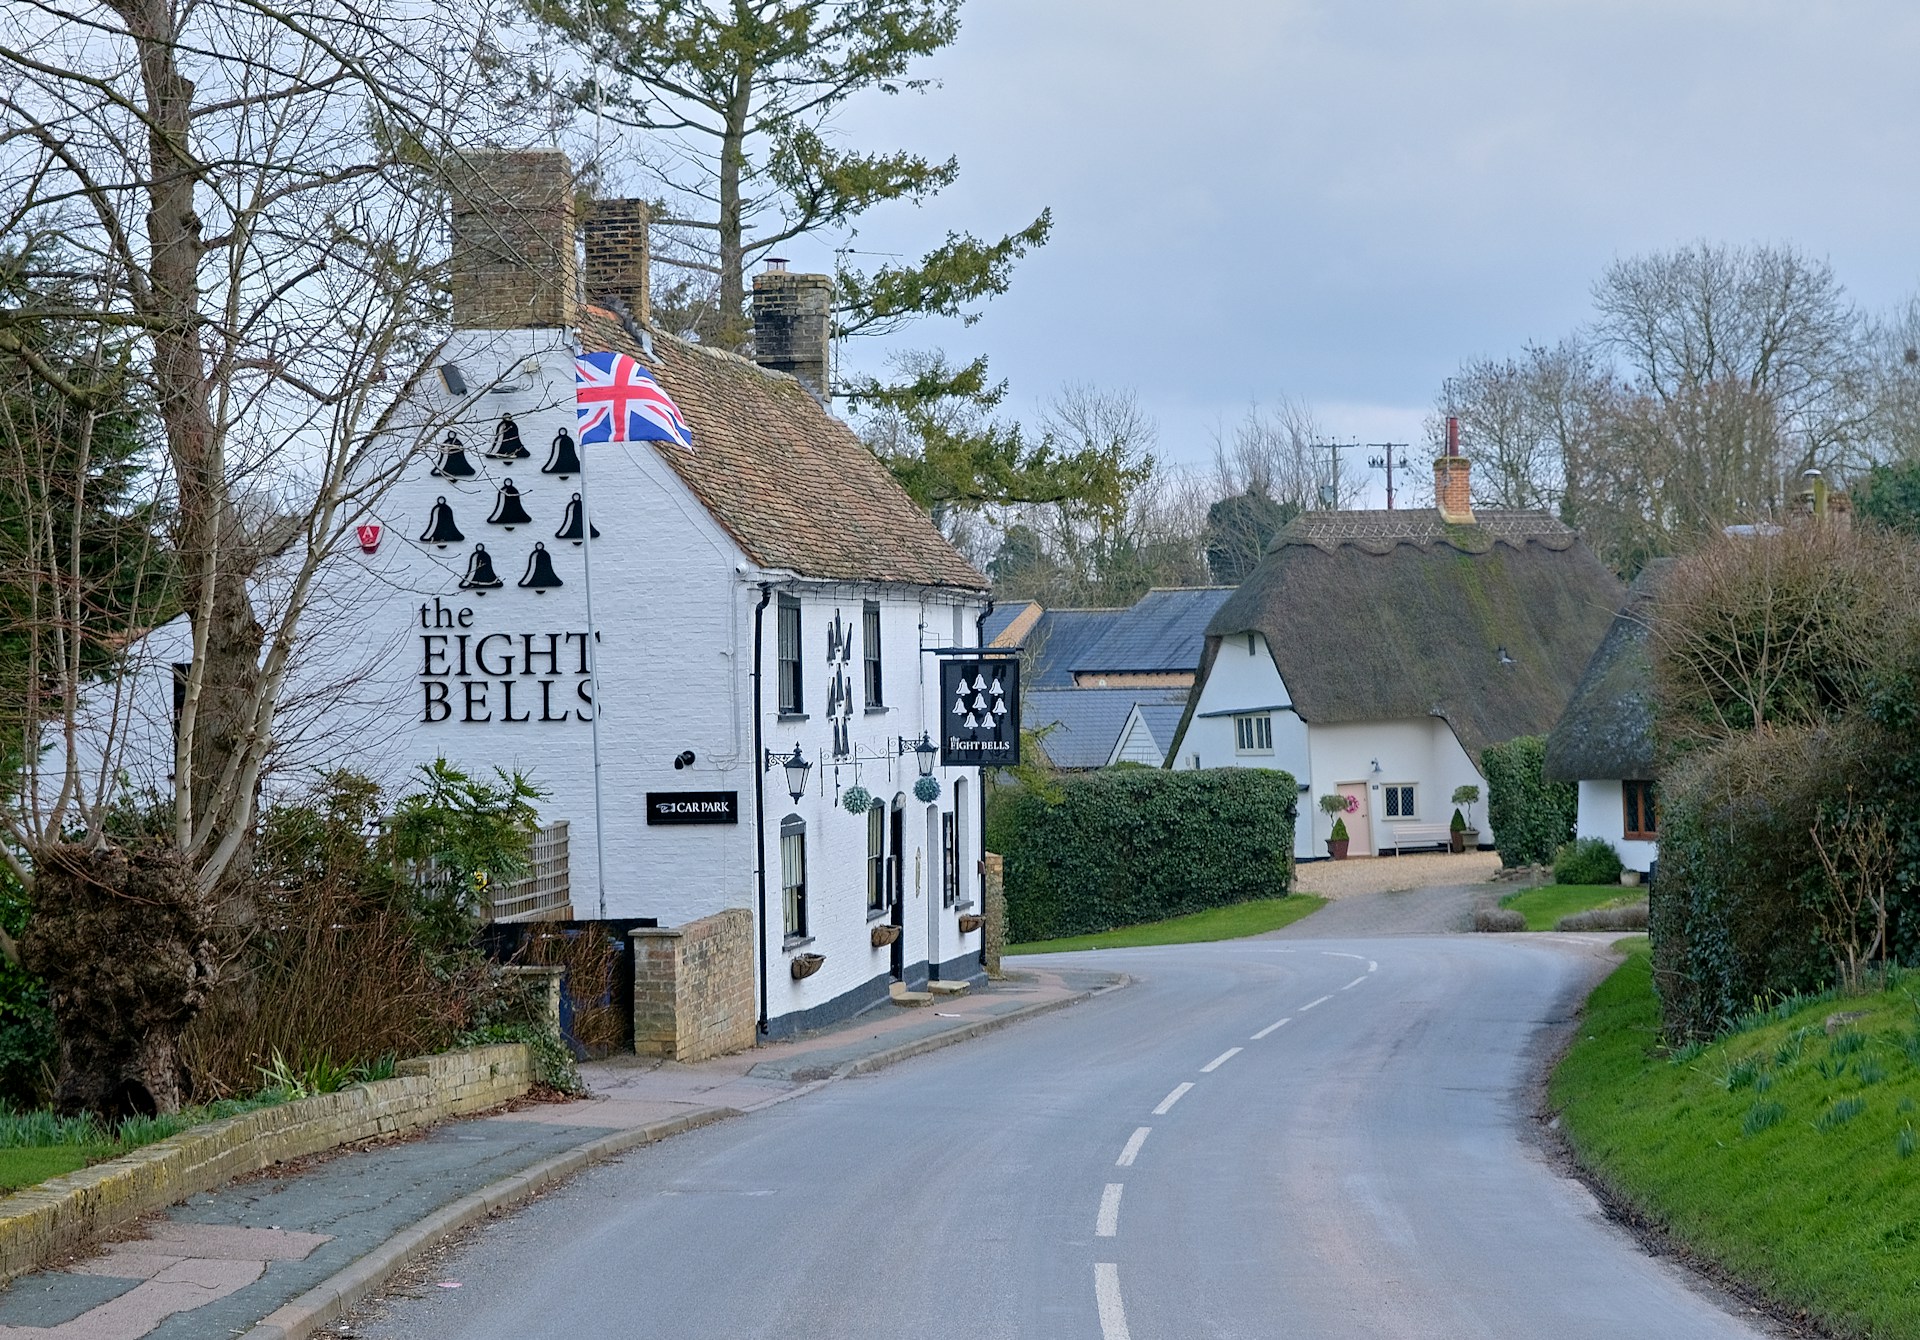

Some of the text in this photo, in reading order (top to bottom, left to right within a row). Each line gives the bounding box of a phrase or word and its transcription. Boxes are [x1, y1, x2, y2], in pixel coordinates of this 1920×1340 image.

[420, 597, 474, 628] the
[419, 631, 601, 676] EIGHT
[419, 679, 601, 723] BELLS
[950, 741, 1010, 750] EIGHT BELLS
[677, 802, 730, 813] CAR PARK
